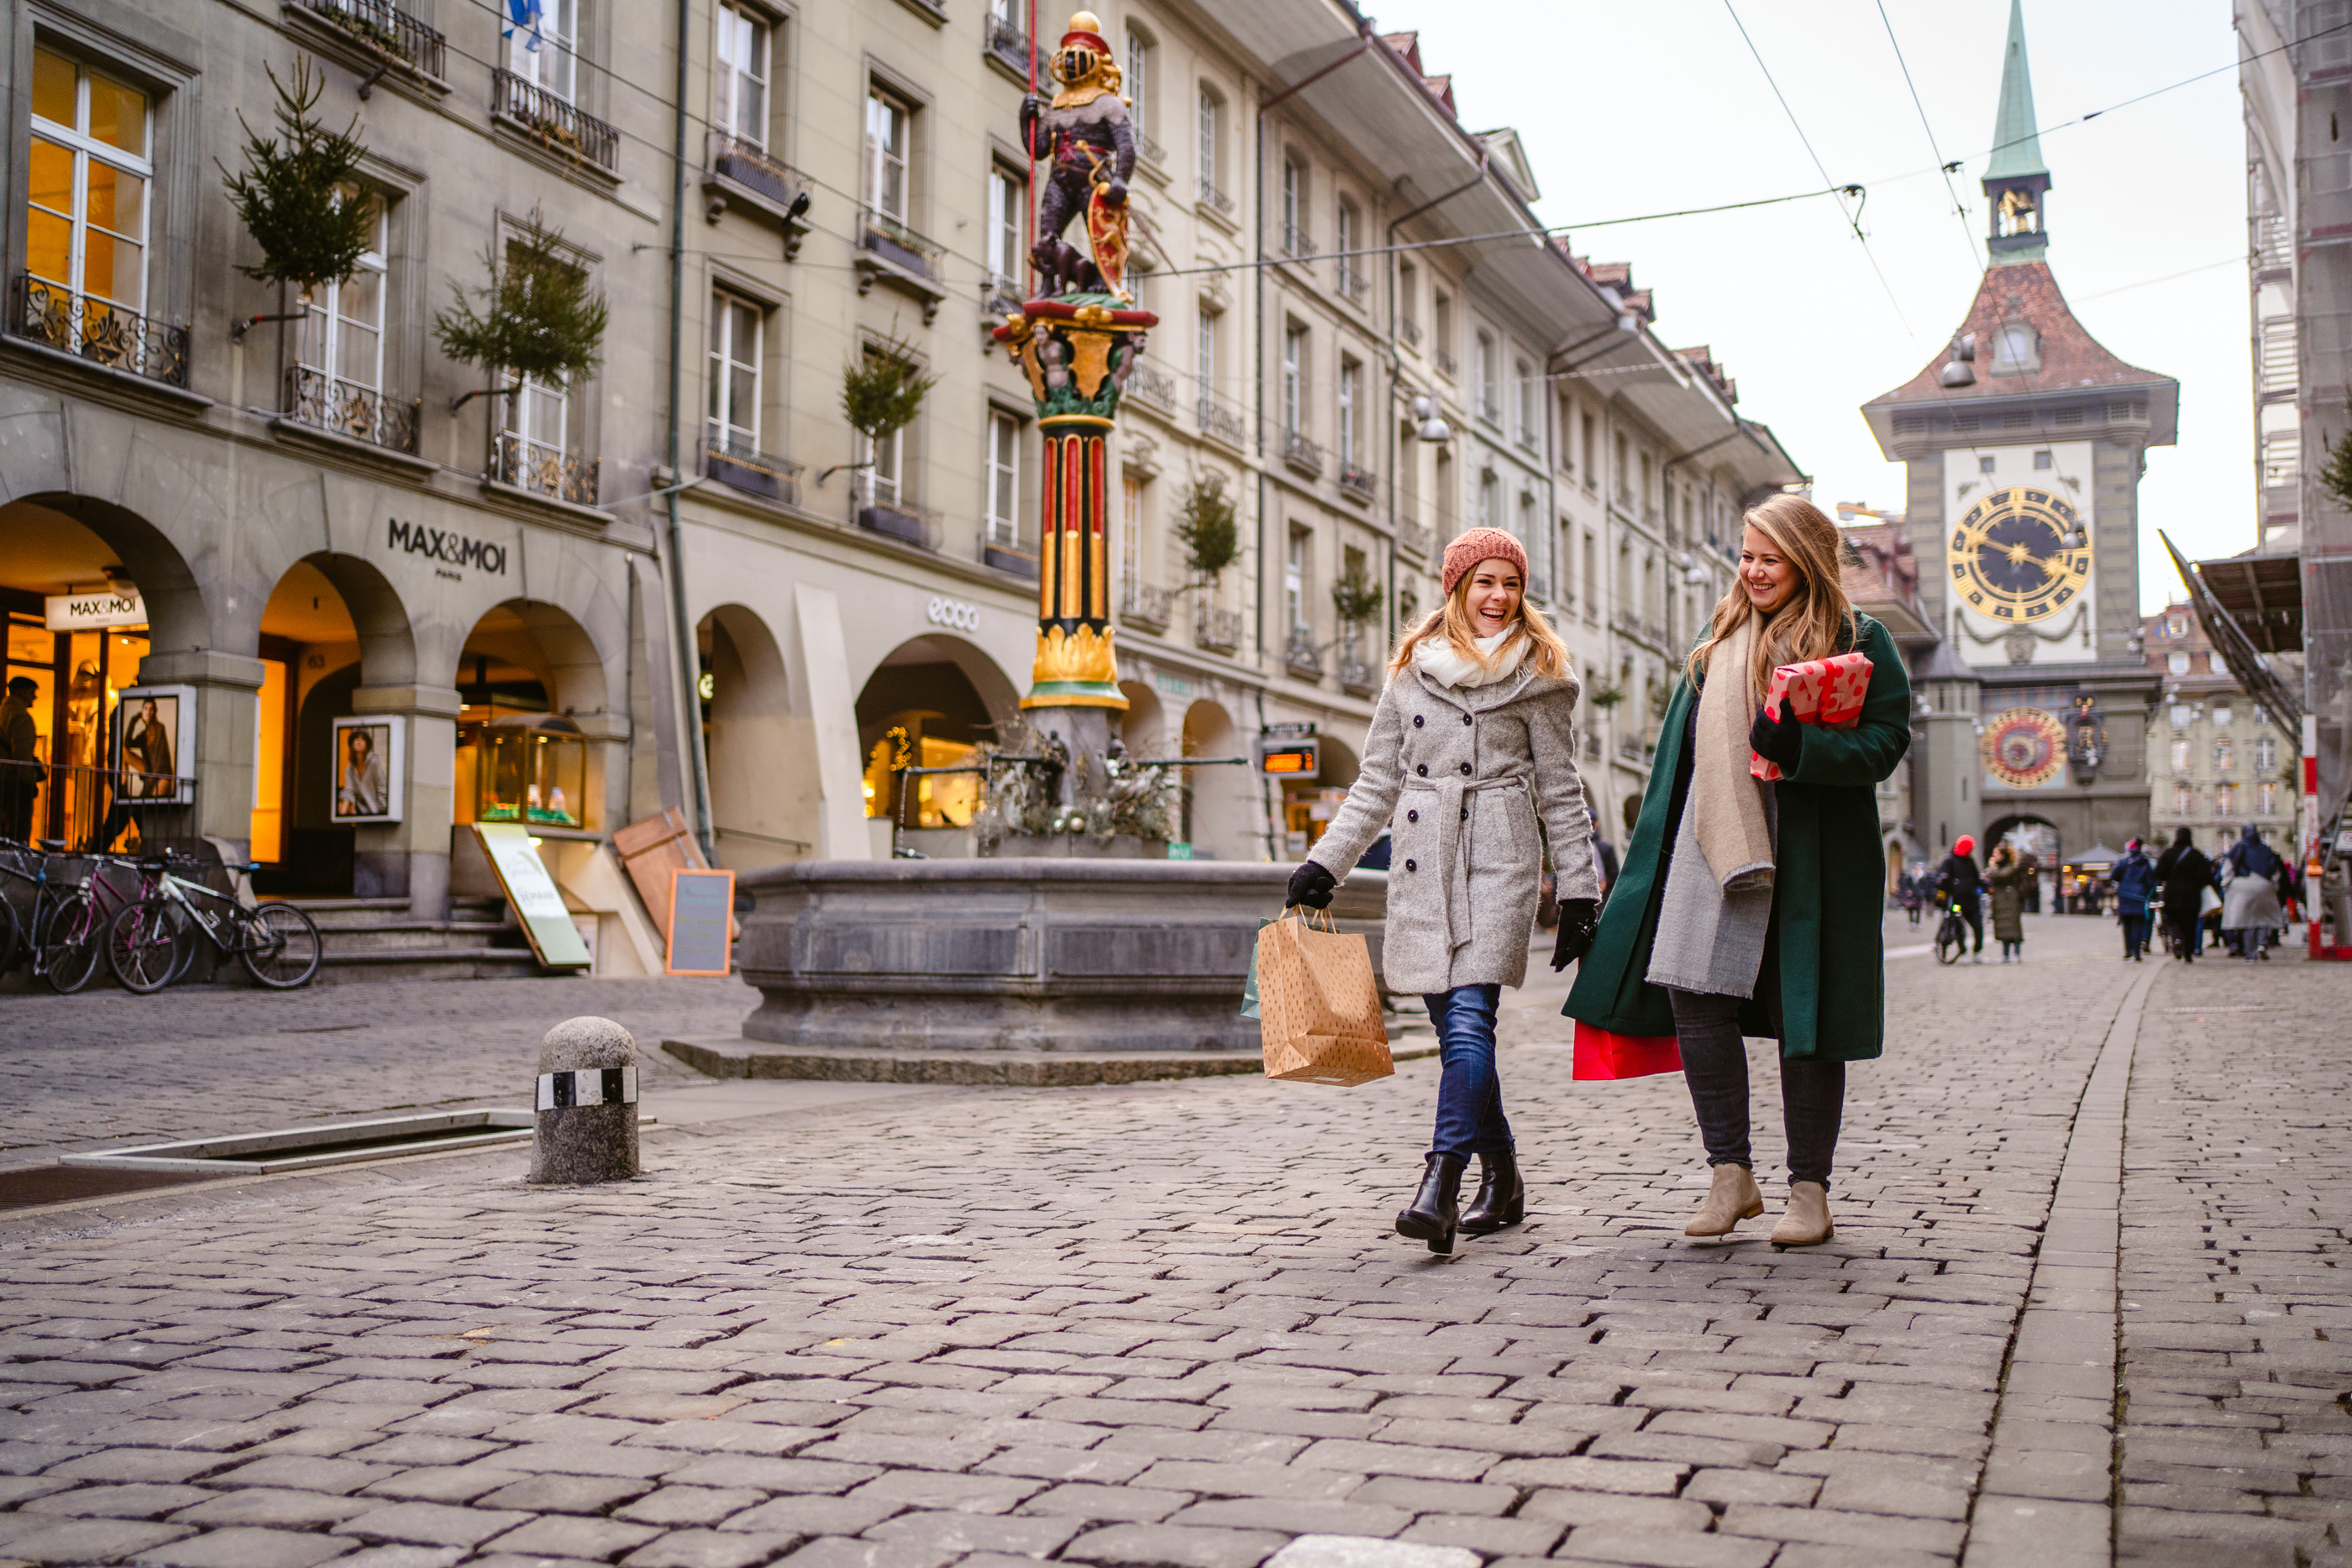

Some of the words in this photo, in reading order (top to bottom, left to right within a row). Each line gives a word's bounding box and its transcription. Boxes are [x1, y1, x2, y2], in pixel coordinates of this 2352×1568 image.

[388, 517, 507, 575] MAX&MOI
[435, 568, 463, 583] PARIS
[70, 598, 136, 617] MAX&MOI
